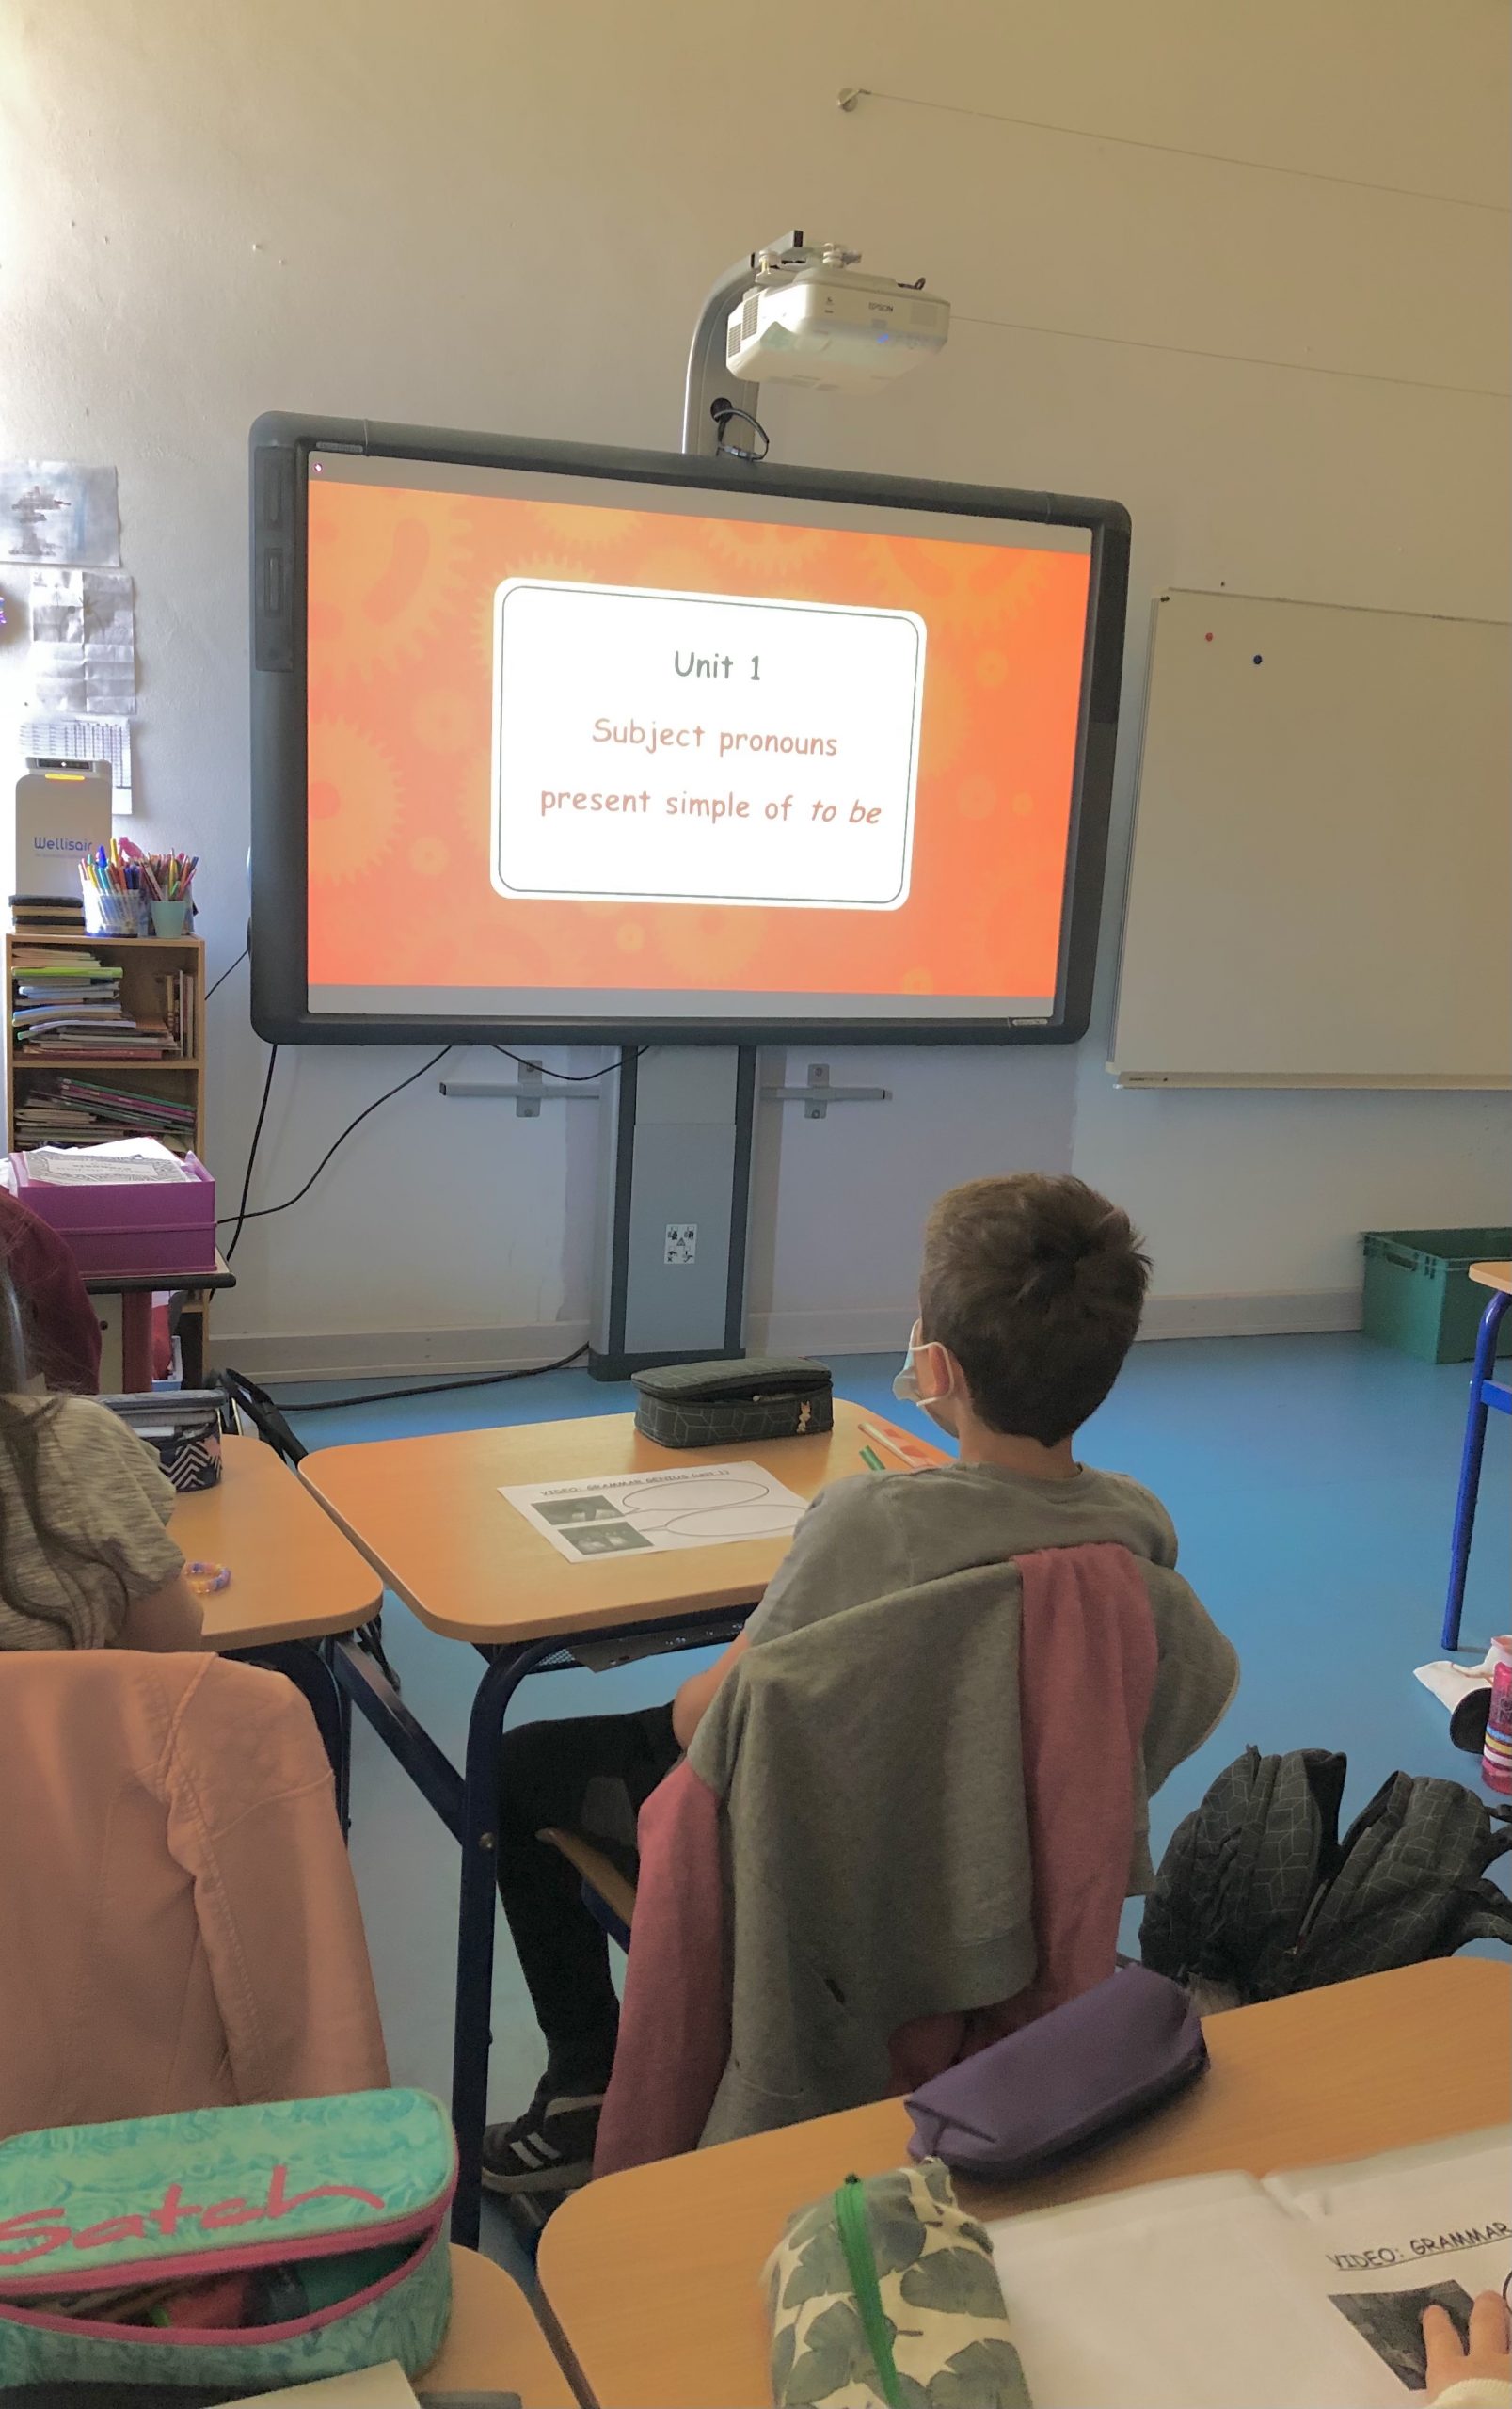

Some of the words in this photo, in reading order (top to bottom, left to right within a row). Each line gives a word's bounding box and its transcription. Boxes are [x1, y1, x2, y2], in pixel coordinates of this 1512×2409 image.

[674, 650, 734, 679] Unit
[750, 655, 761, 680] 1
[592, 718, 706, 754] Subject
[719, 731, 837, 757] pronouns
[541, 790, 651, 817] present
[666, 791, 750, 824] simple
[764, 794, 794, 822] of
[811, 799, 837, 822] to
[848, 799, 882, 824] be
[34, 837, 92, 851] Wellisair
[1326, 2247, 1405, 2270] VIDEO:
[1409, 2221, 1512, 2256] GRAMMAR
